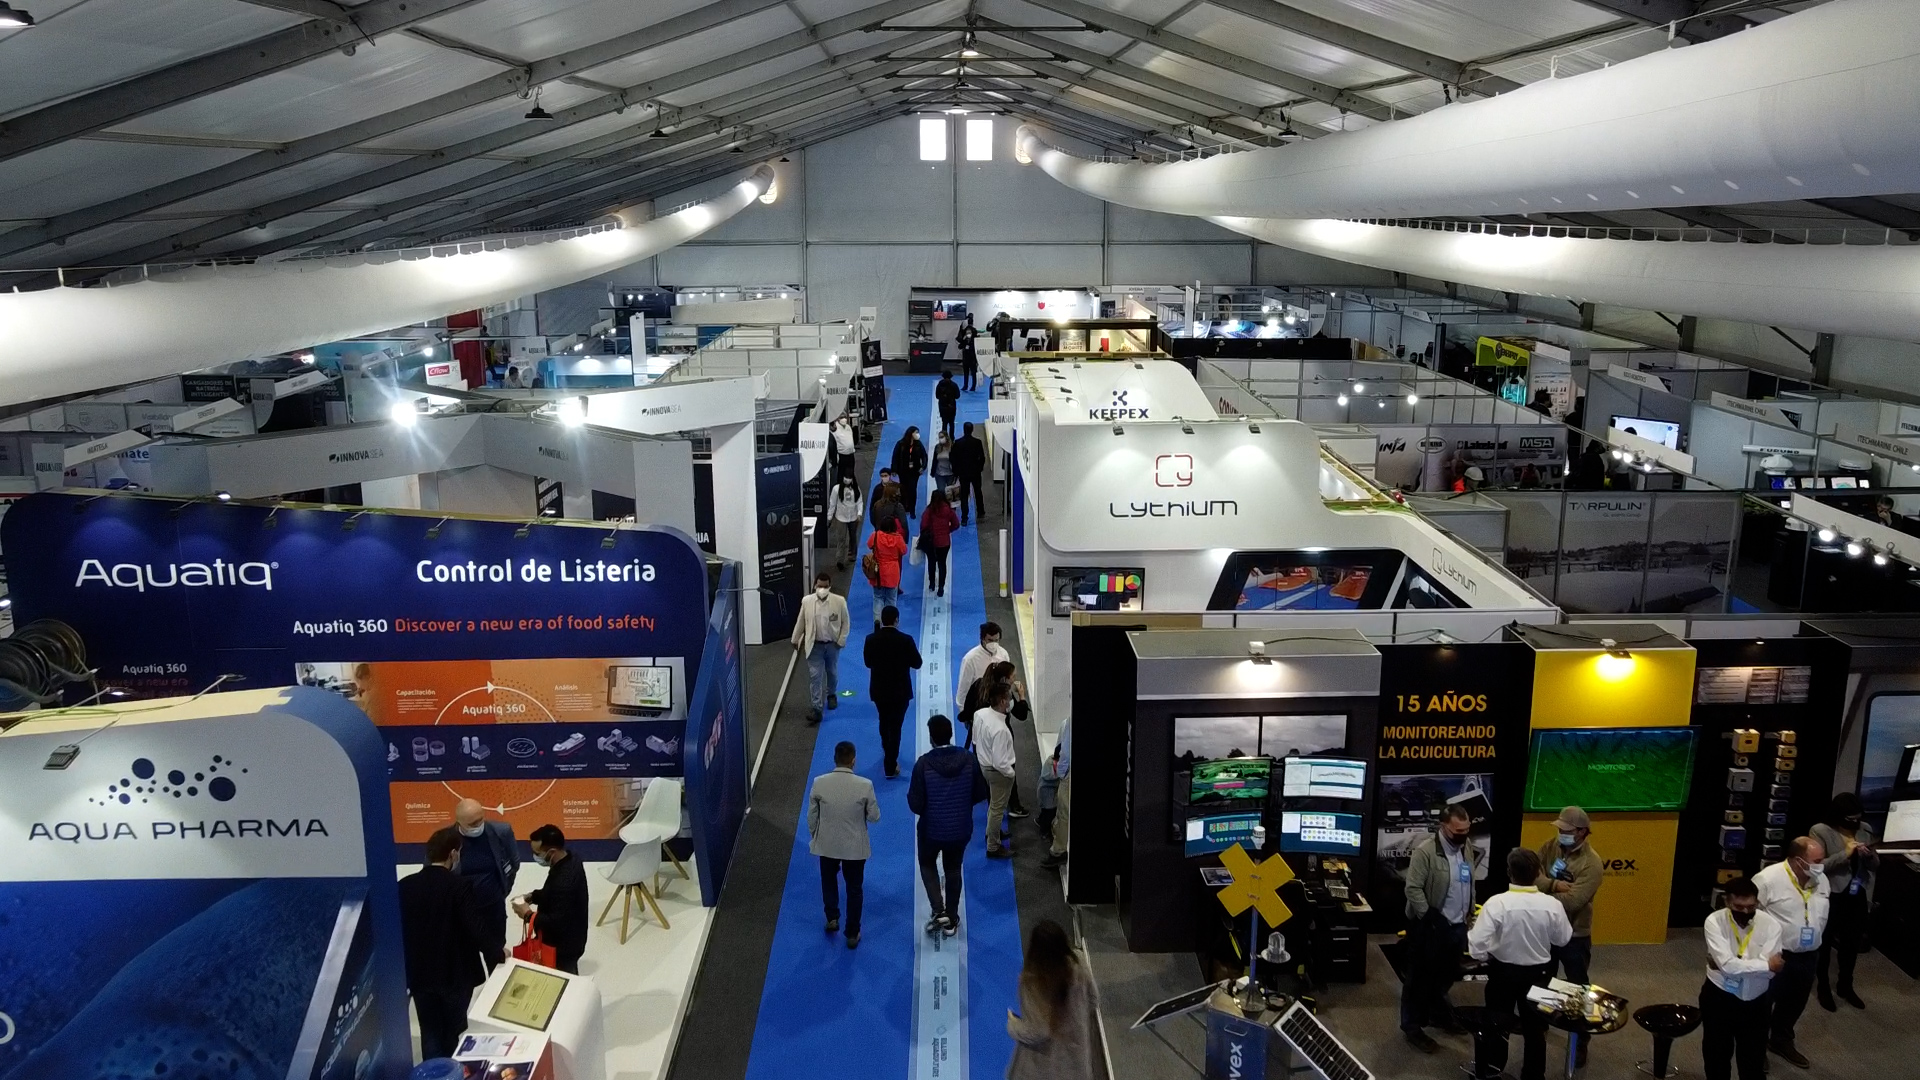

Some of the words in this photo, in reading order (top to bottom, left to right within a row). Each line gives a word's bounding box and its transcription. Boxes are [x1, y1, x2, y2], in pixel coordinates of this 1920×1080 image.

[826, 386, 848, 395] AQUASUR
[648, 403, 682, 417] INNOVASEA
[1089, 407, 1150, 420] KEEPEX
[991, 414, 1015, 424] AQUASUR
[800, 439, 826, 450] AQUASUR
[1520, 437, 1553, 448] MSA
[339, 449, 384, 464] INNOVASEA
[1569, 502, 1643, 511] TARPULIN
[416, 559, 513, 583] Control
[521, 559, 552, 582] de
[560, 558, 657, 582] Listeria
[293, 619, 355, 637] Aquatiq
[358, 618, 388, 634] 360
[395, 617, 462, 633] Discover
[466, 620, 476, 632] a
[480, 619, 514, 632] new
[518, 619, 544, 631] era
[547, 616, 564, 632] of
[566, 615, 603, 631] food
[606, 613, 655, 632] safety
[122, 663, 164, 676] Aquatiq
[166, 663, 187, 674] 360
[395, 688, 436, 697] Capacitación
[1396, 694, 1420, 713] 15
[1426, 689, 1488, 713] AÑOS
[462, 703, 503, 717] Aquatiq
[505, 703, 526, 714] 360
[1383, 725, 1496, 740] MONITOREANDO
[1379, 745, 1396, 759] LA
[1400, 744, 1496, 760] ACUICULTURA
[28, 822, 138, 844] AQUA
[151, 819, 330, 841] PHARMA
[1228, 1041, 1243, 1080] vex
